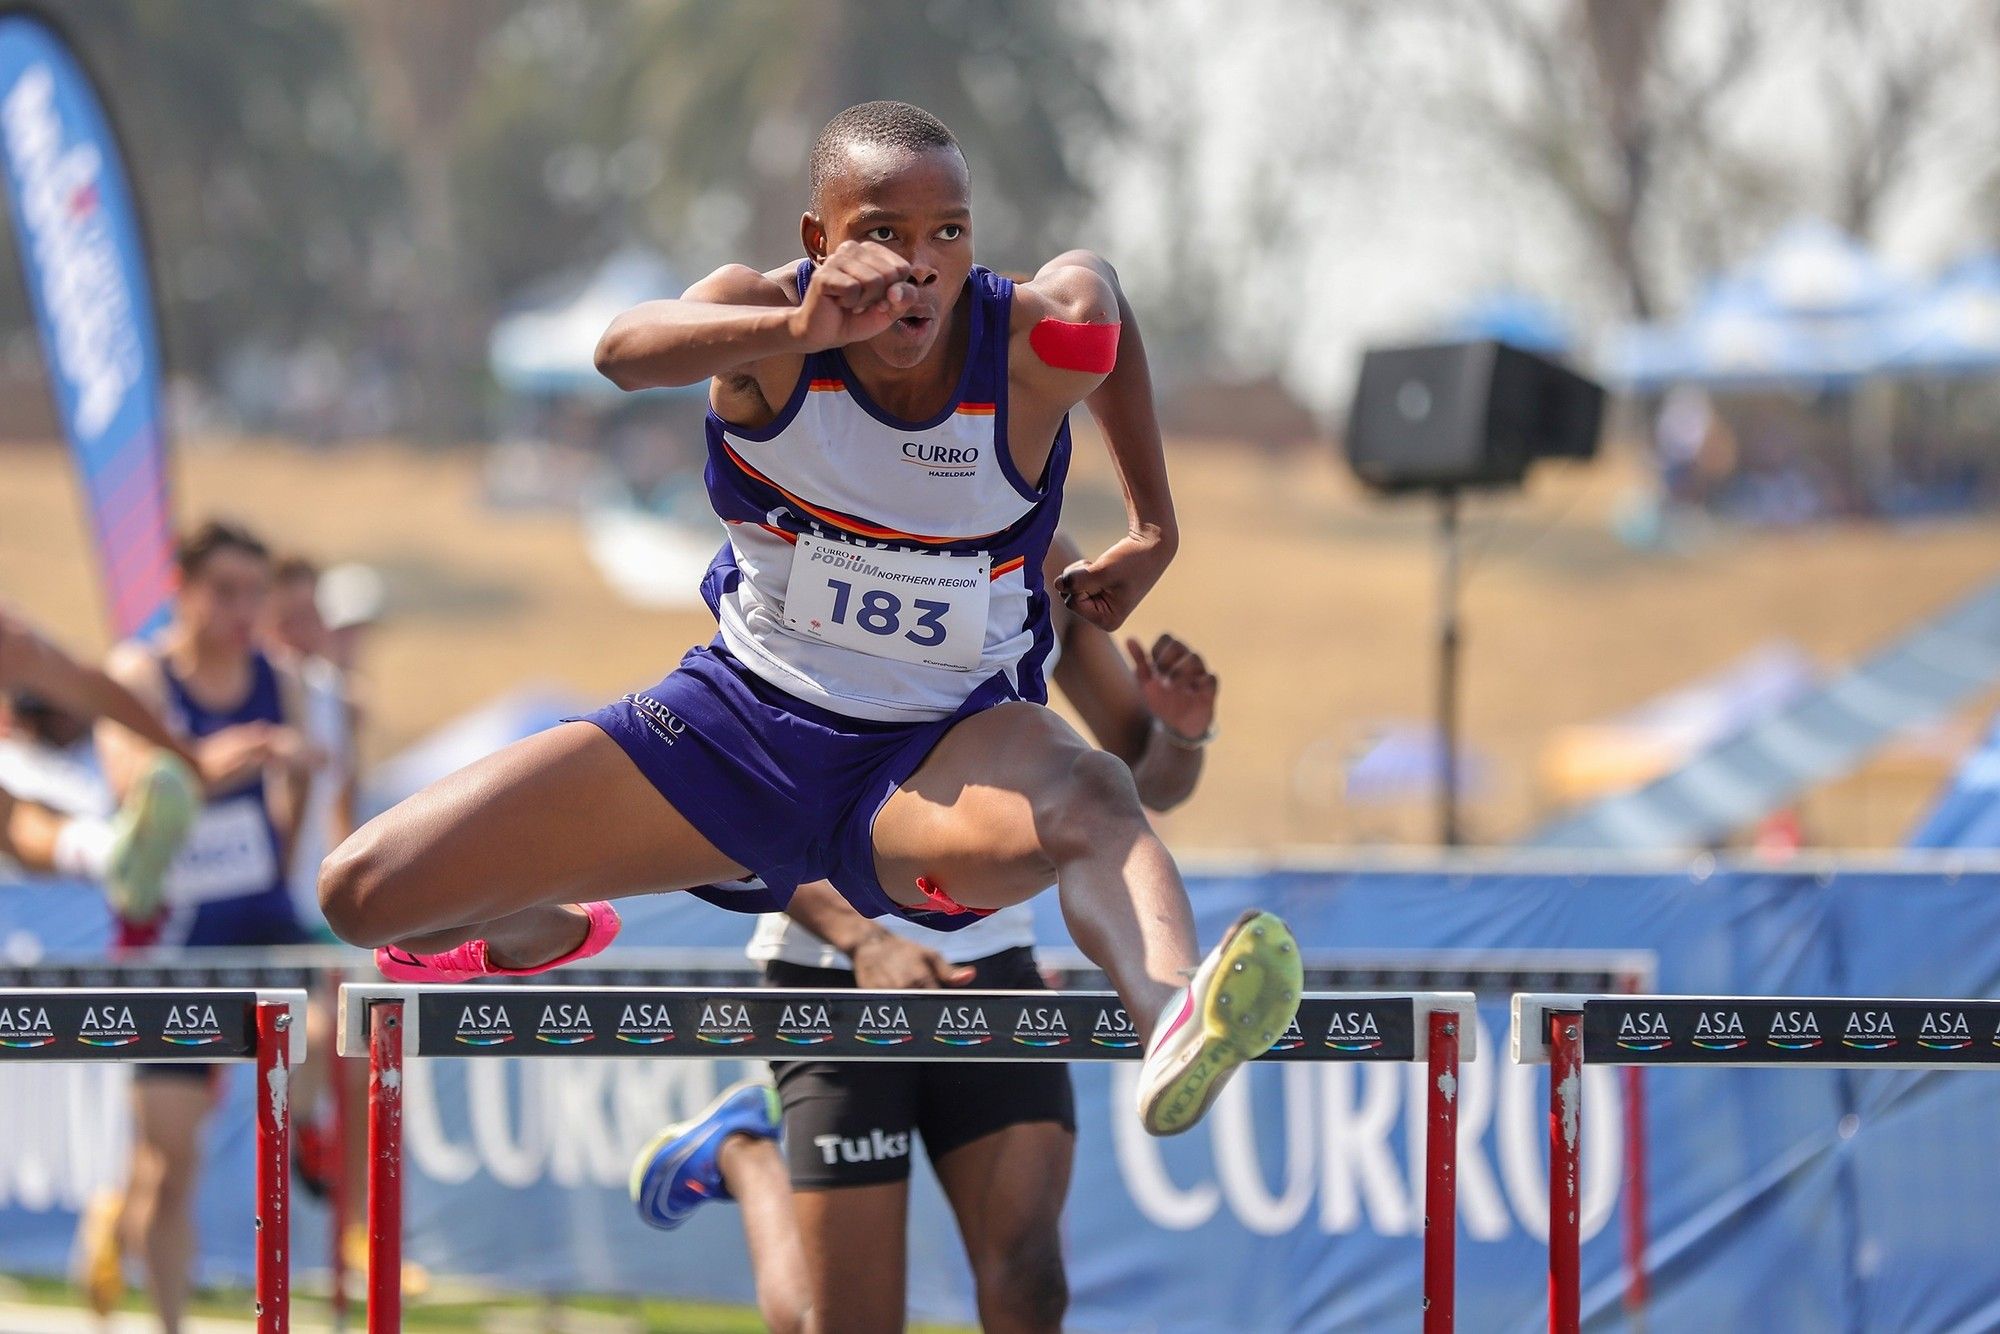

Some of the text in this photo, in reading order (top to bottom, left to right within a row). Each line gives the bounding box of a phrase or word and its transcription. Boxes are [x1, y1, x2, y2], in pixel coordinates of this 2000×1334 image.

[902, 442, 979, 463] CURRO
[816, 546, 849, 558] CURRO
[810, 552, 977, 588] PODIUM NORTHERN REGION
[826, 578, 951, 647] 183
[0, 1007, 51, 1030] ASA
[82, 1006, 135, 1029] ASA
[166, 1005, 218, 1028] ASA
[459, 1006, 510, 1028] ASA
[540, 1005, 591, 1027] ASA
[620, 1004, 671, 1026] ASA
[700, 1004, 751, 1027] ASA
[780, 1005, 830, 1027] ASA
[859, 1006, 909, 1028] ASA
[938, 1007, 988, 1028] ASA
[1016, 1009, 1066, 1030] ASA
[1329, 1013, 1378, 1034] ASA
[1620, 1013, 1668, 1033] ASA
[1696, 1012, 1743, 1033] ASA
[1771, 1012, 1818, 1032] ASA
[1846, 1012, 1894, 1032] ASA
[1921, 1013, 1969, 1033] ASA
